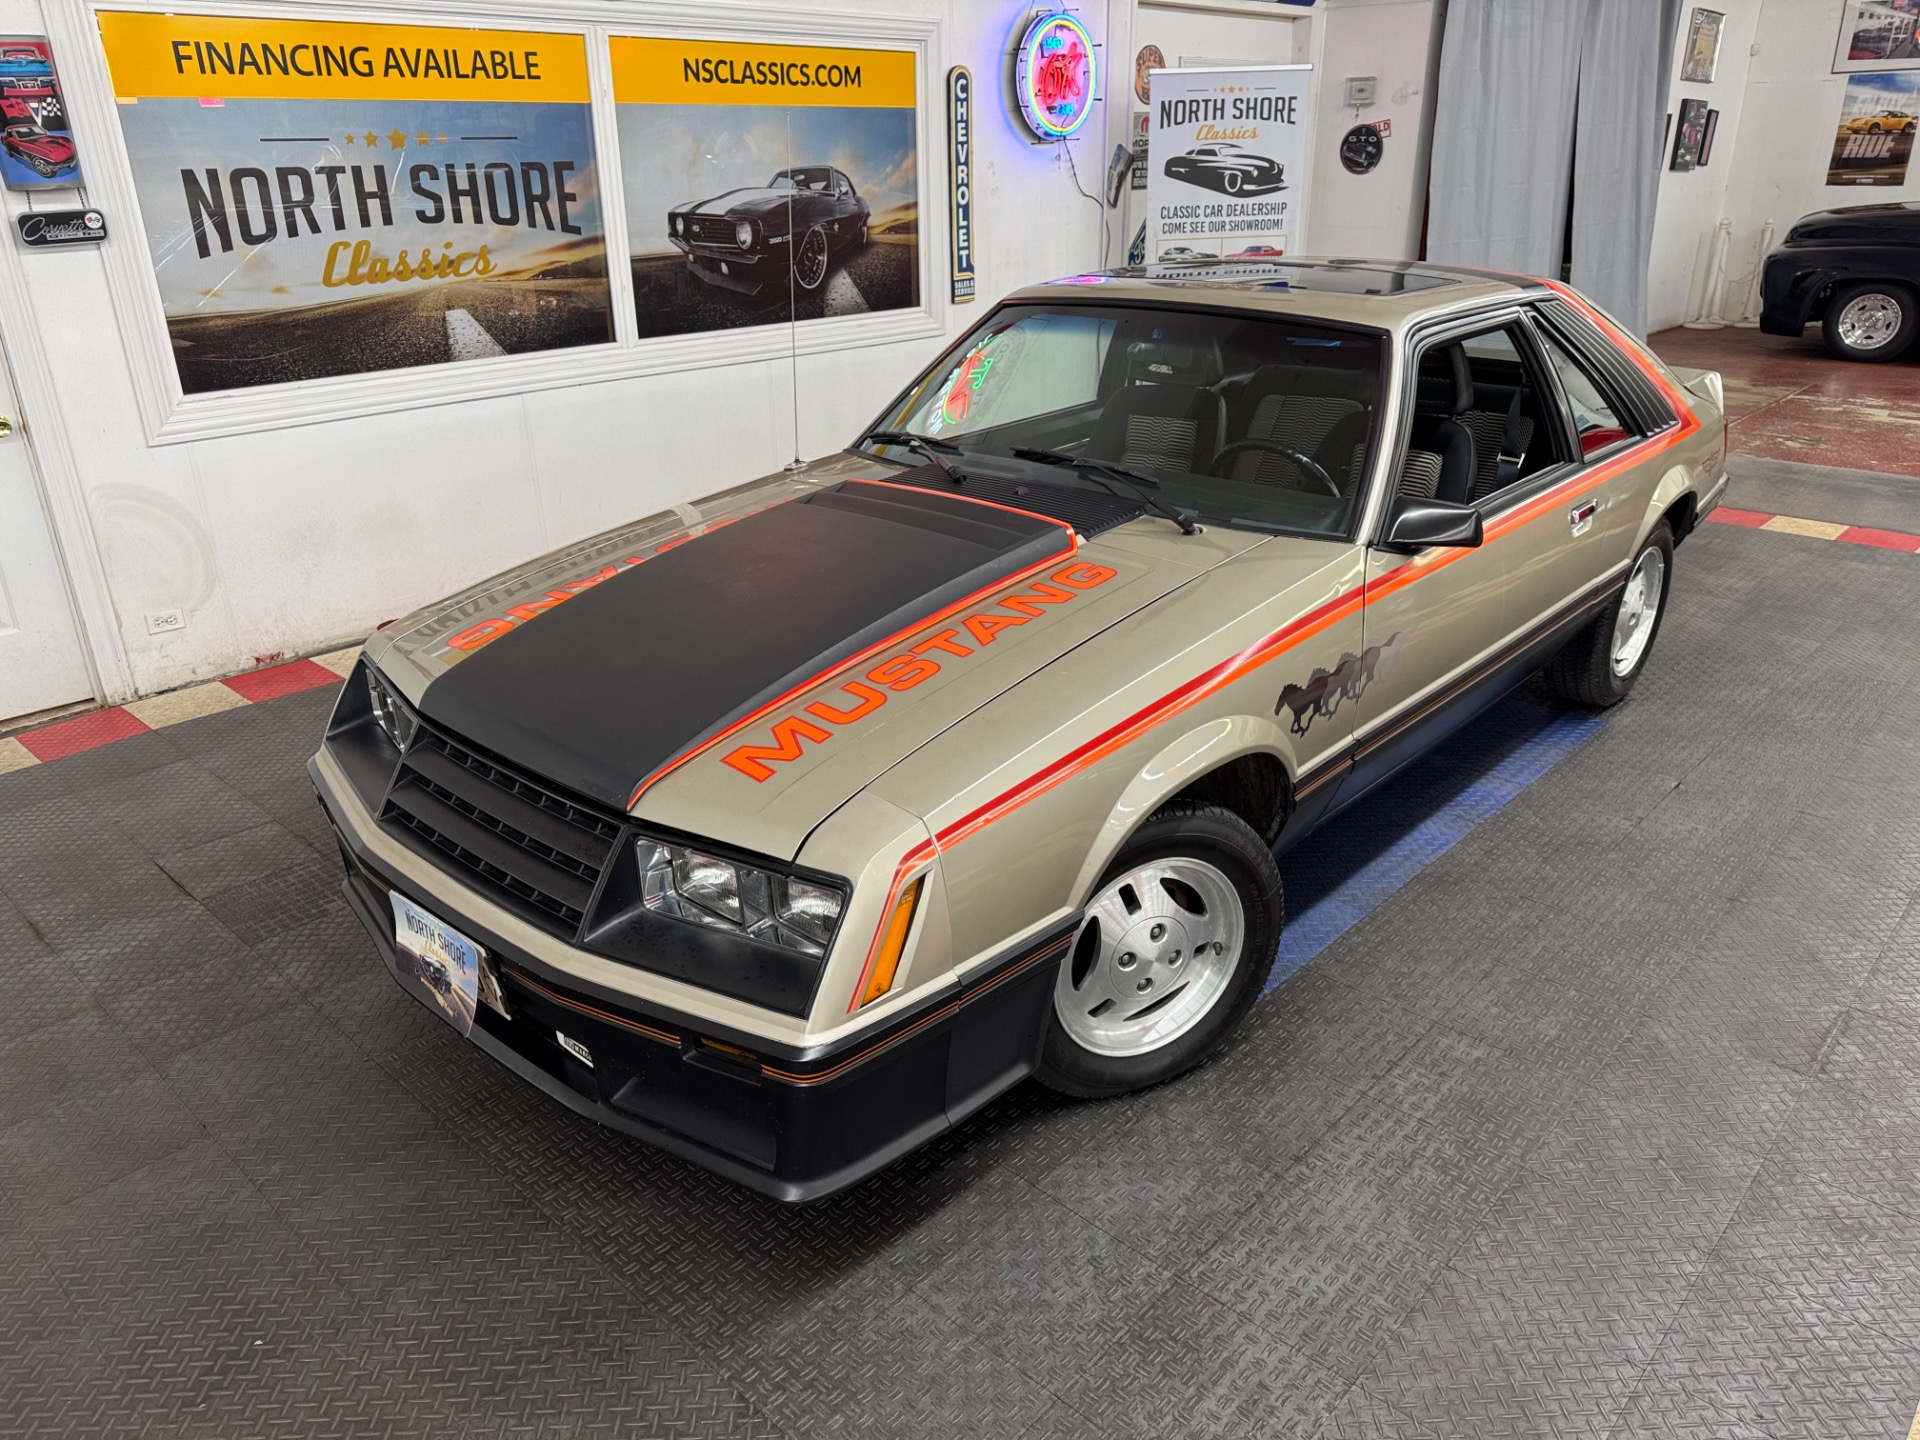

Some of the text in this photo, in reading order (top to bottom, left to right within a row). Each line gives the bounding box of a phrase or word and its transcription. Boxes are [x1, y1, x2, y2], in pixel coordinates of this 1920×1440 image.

[1043, 37, 1063, 49] USED
[171, 40, 542, 80] FINANCING AVAILABLE
[682, 58, 862, 88] NSCLASSICS.COM
[1160, 96, 1298, 129] NORTH SHORE
[1195, 124, 1259, 141] Classics
[1842, 134, 1895, 158] RIDE
[956, 78, 971, 269] CHEVROLET
[180, 160, 583, 260] NORTH SHORE
[1160, 202, 1288, 220] CLASSIC CAR DEALERSHIP
[22, 216, 85, 242] Corvette
[1162, 218, 1283, 234] COME SEE OUR SHOWROOM!
[321, 240, 498, 289] Classics
[720, 562, 1119, 784] MUSTANG
[404, 908, 467, 976] NORTH SHORE
